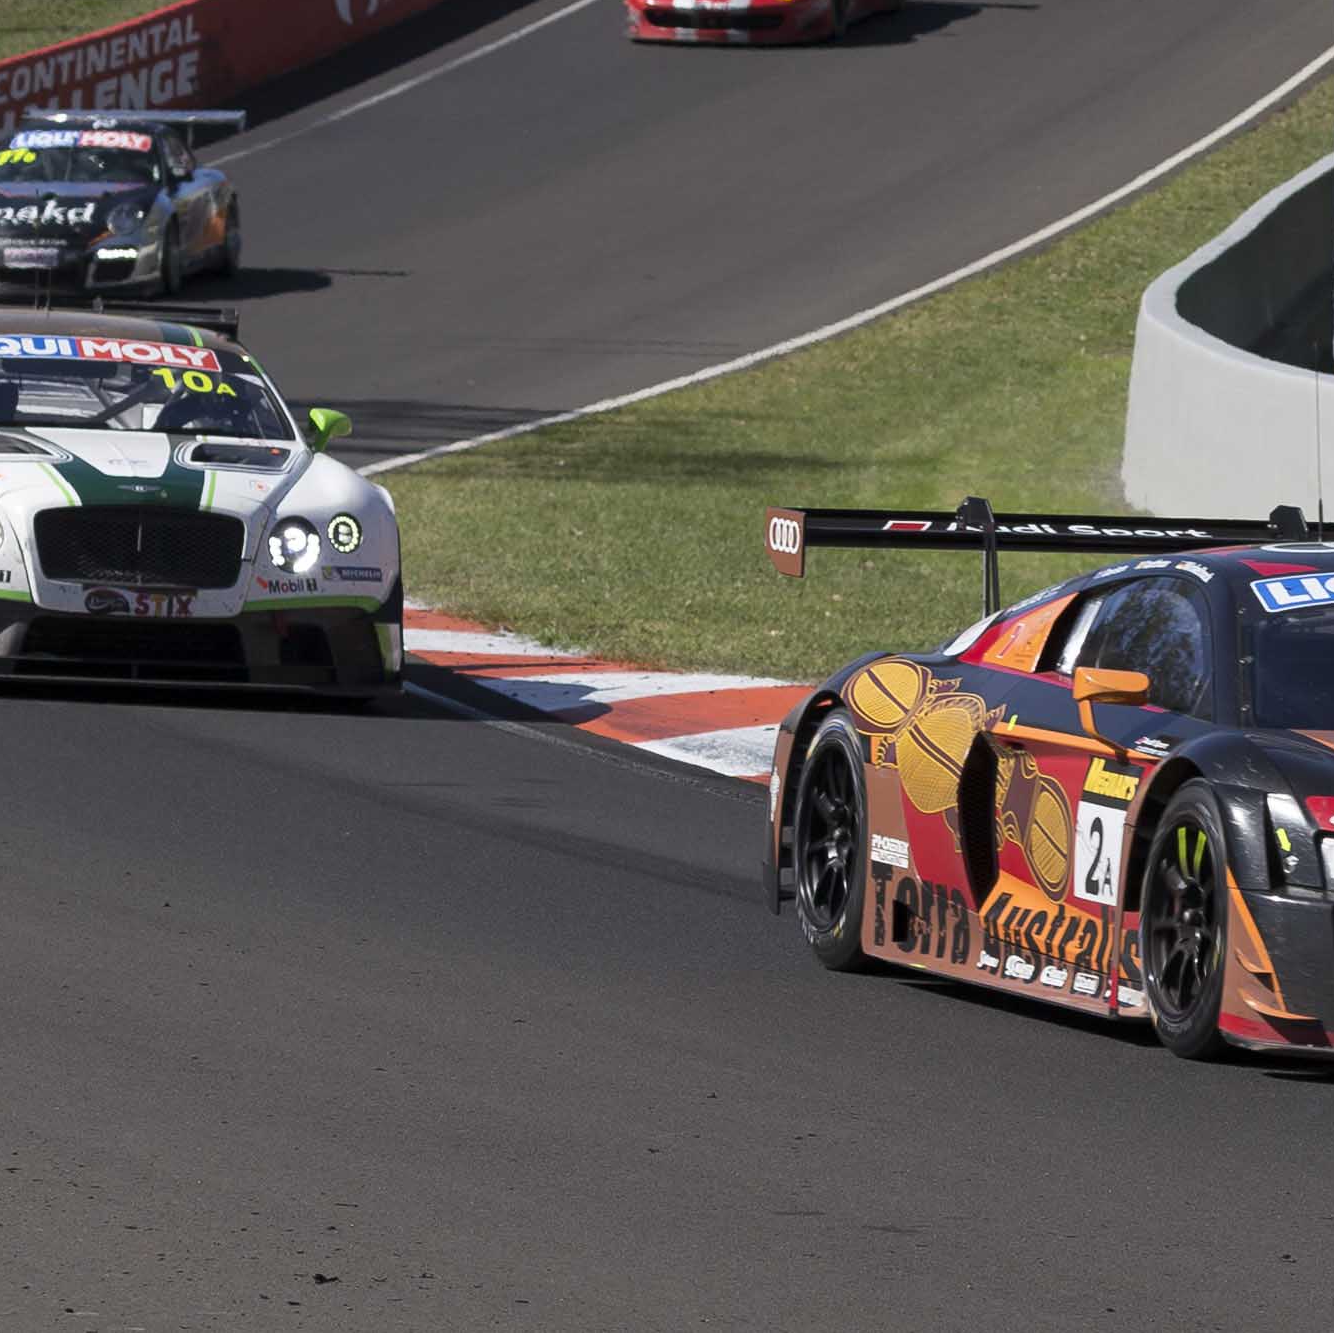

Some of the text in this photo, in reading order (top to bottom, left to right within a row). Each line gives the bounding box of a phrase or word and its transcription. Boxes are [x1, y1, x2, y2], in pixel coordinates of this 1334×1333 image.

[82, 339, 211, 367] MOLY
[1067, 524, 1213, 538] Sport
[267, 578, 304, 593] Mobil
[134, 592, 194, 617] STIX
